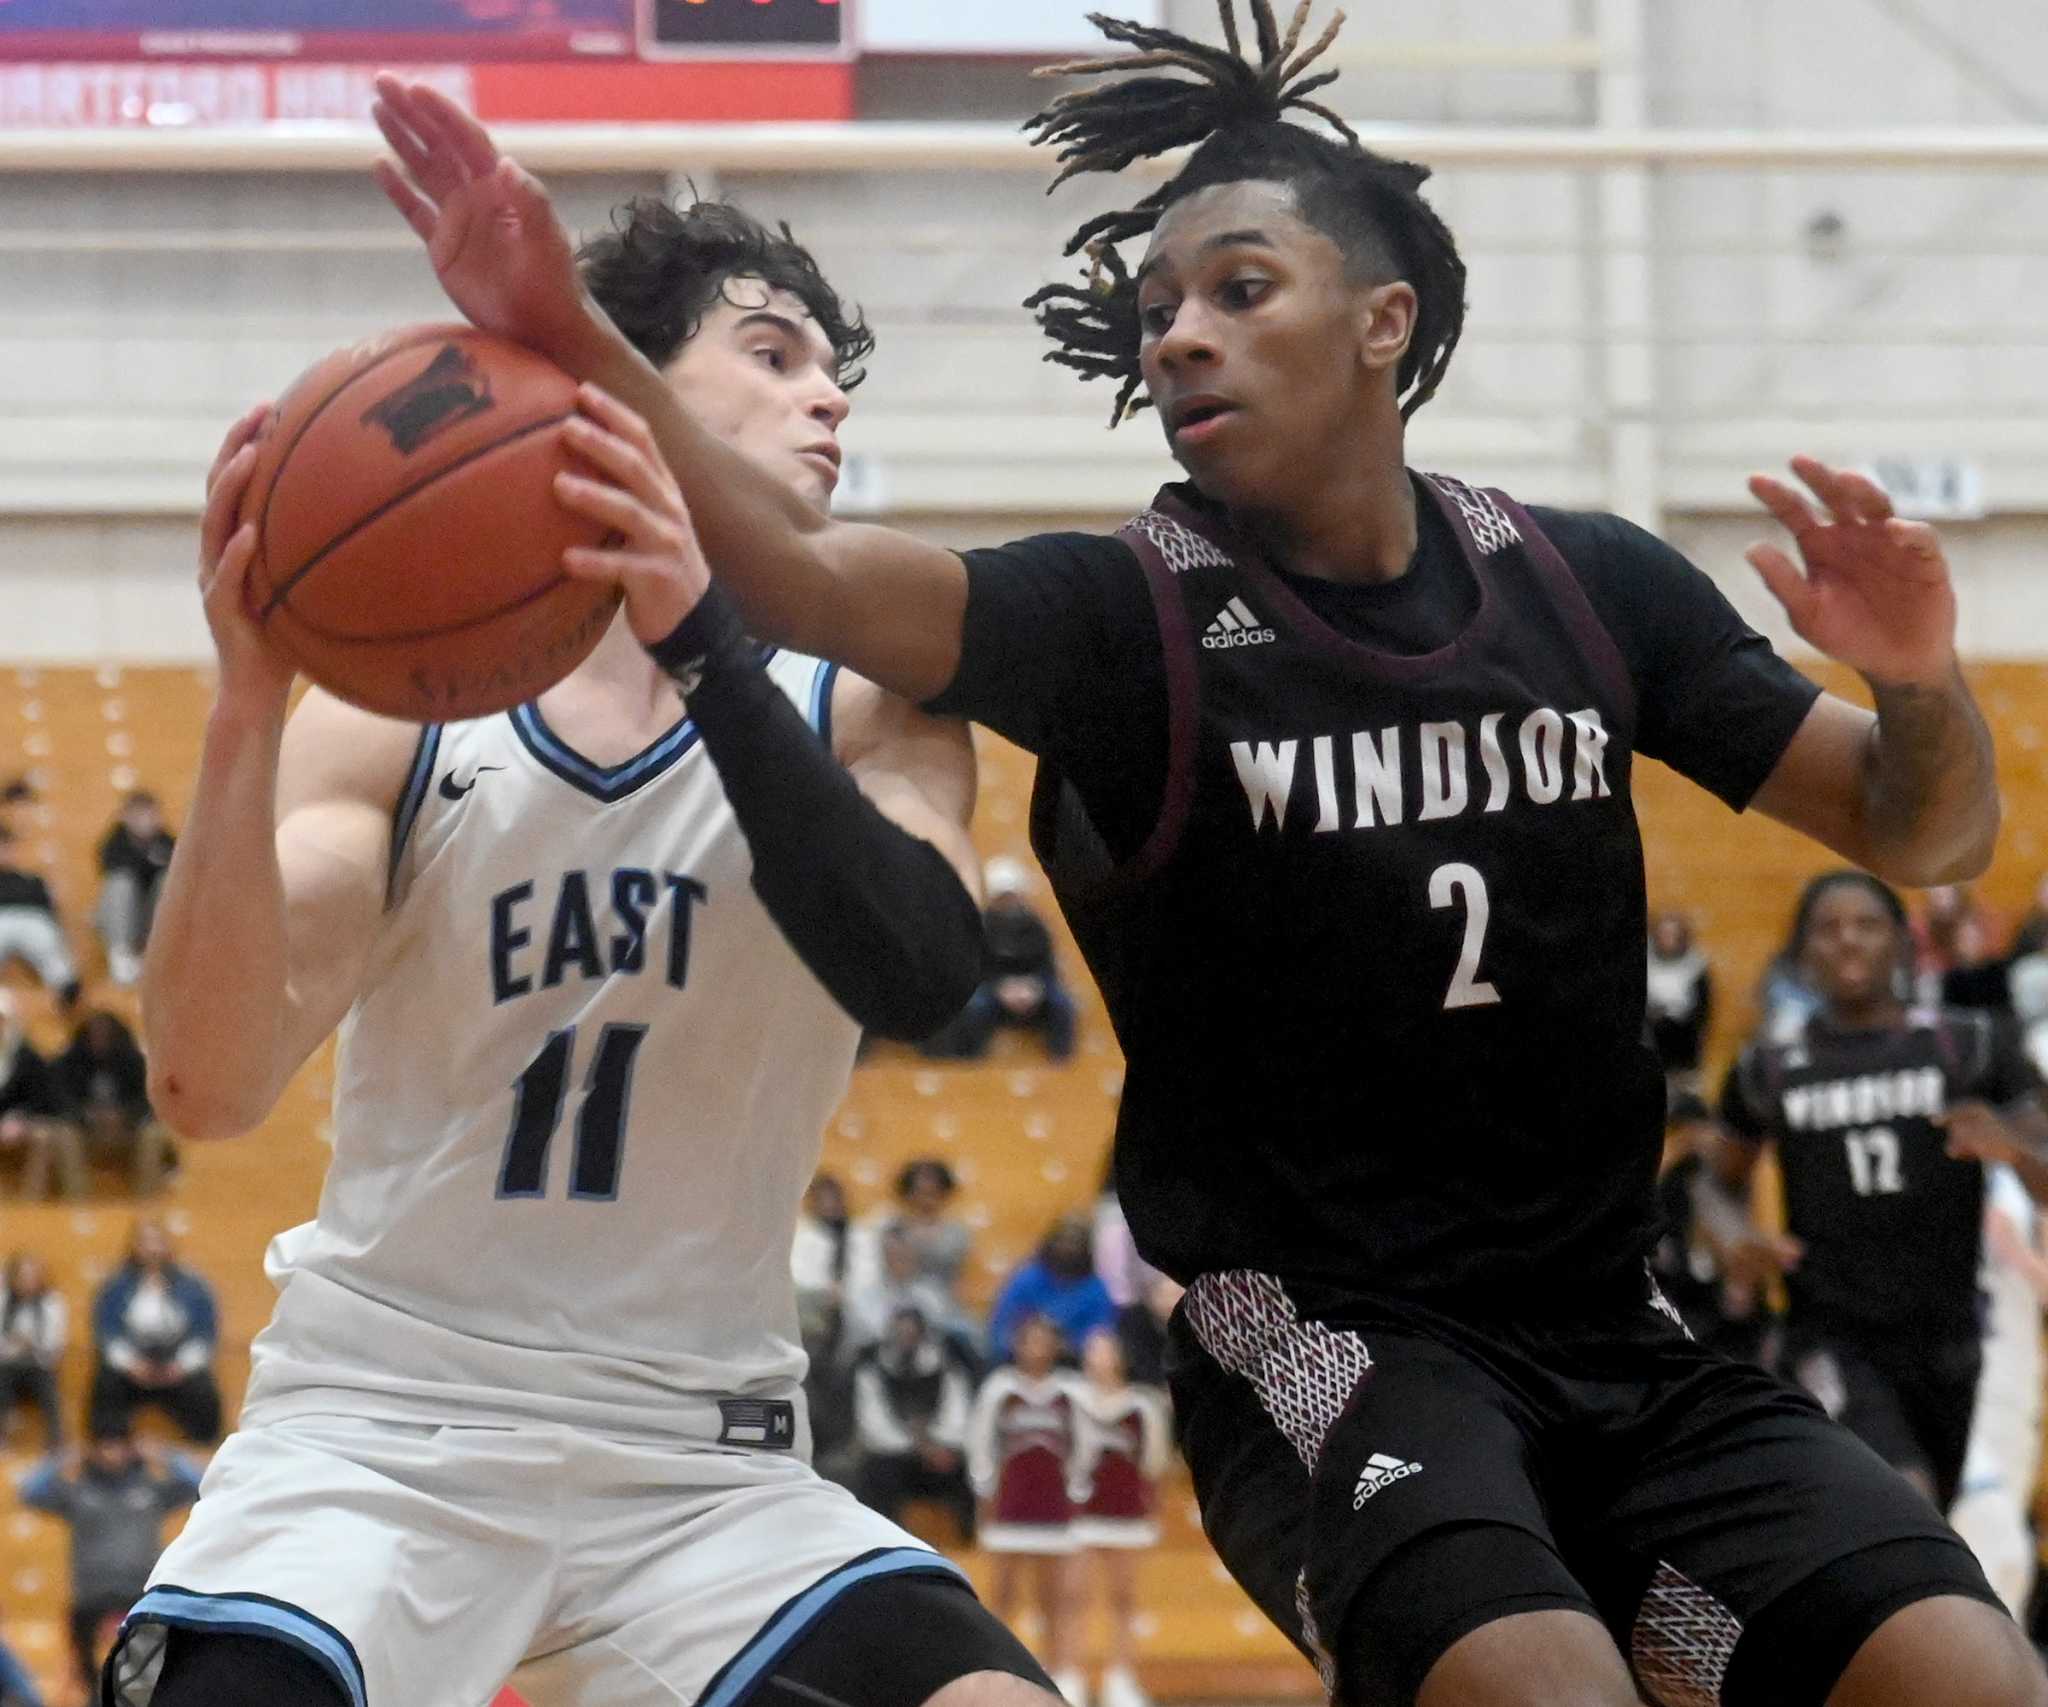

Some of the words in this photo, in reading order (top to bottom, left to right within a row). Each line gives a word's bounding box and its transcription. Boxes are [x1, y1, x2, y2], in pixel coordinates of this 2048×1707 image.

[1201, 628, 1276, 649] adidas
[1229, 707, 1612, 834] WINDSOR
[489, 866, 709, 1007] EAST
[1428, 862, 1502, 1010] 2
[493, 1021, 651, 1202] 11
[1784, 1065, 1945, 1131] WINDSOR
[1846, 1126, 1903, 1197] 12
[1353, 1462, 1423, 1511] adidas
